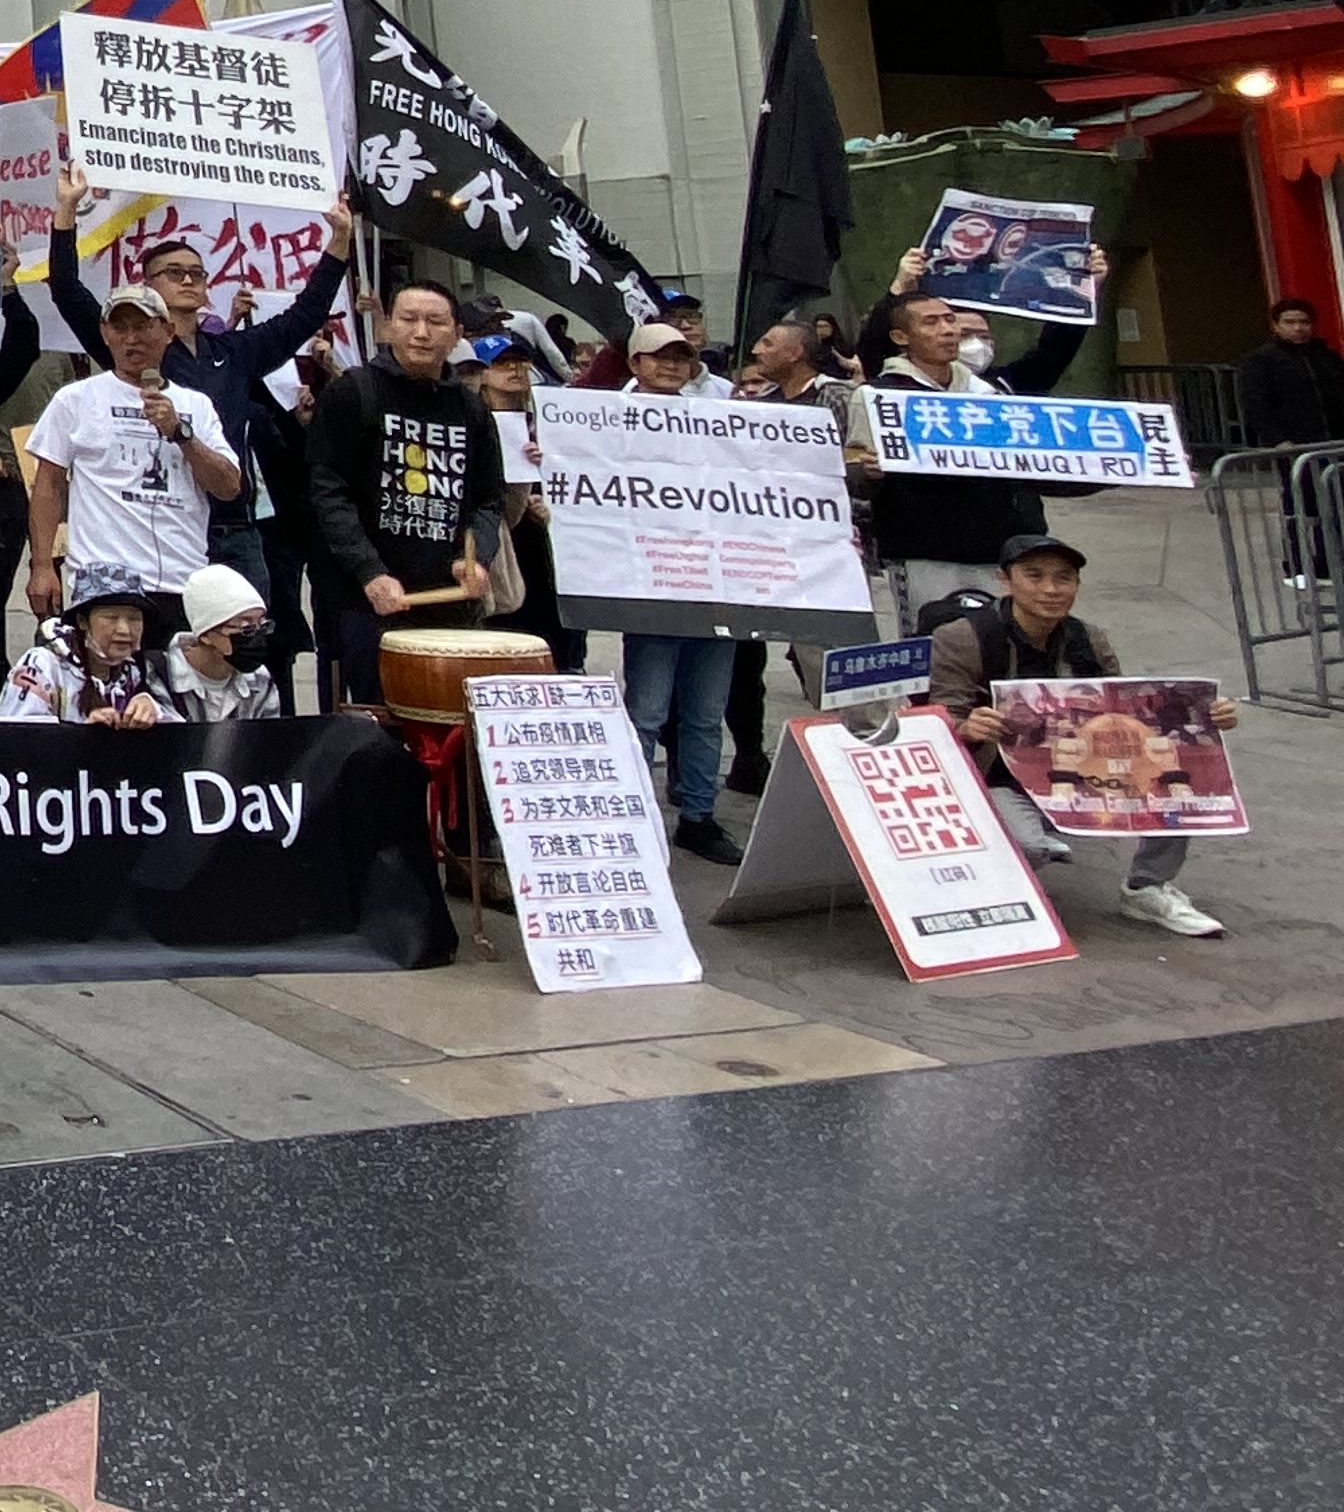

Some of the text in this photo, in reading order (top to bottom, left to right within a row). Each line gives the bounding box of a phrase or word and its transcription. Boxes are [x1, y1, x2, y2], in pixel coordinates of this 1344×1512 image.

[93, 29, 291, 89] 釋放基督徒
[99, 77, 297, 136] 停拆十字架
[369, 79, 424, 120] FREE
[429, 100, 482, 149] HONG
[78, 119, 326, 168] Emancipate the Christians,
[85, 148, 327, 192] stop destroying the cross.
[384, 413, 468, 449] FREE
[541, 402, 842, 447] Google #ChinaProtest
[873, 394, 911, 462] 自由
[913, 398, 1127, 450] 共产党下台
[1137, 412, 1182, 478] 民主
[929, 447, 1139, 478] WULUMUQI RD
[547, 471, 841, 523] #A4Revolution
[378, 512, 460, 544] 時代革
[486, 720, 608, 748] 1 公布疫情真相
[493, 760, 509, 786] 2
[181, 768, 305, 849] Day
[500, 797, 515, 824] 3
[519, 868, 648, 896] 4 开放言论自由
[526, 912, 542, 939] 5
[557, 947, 597, 974] 共和
